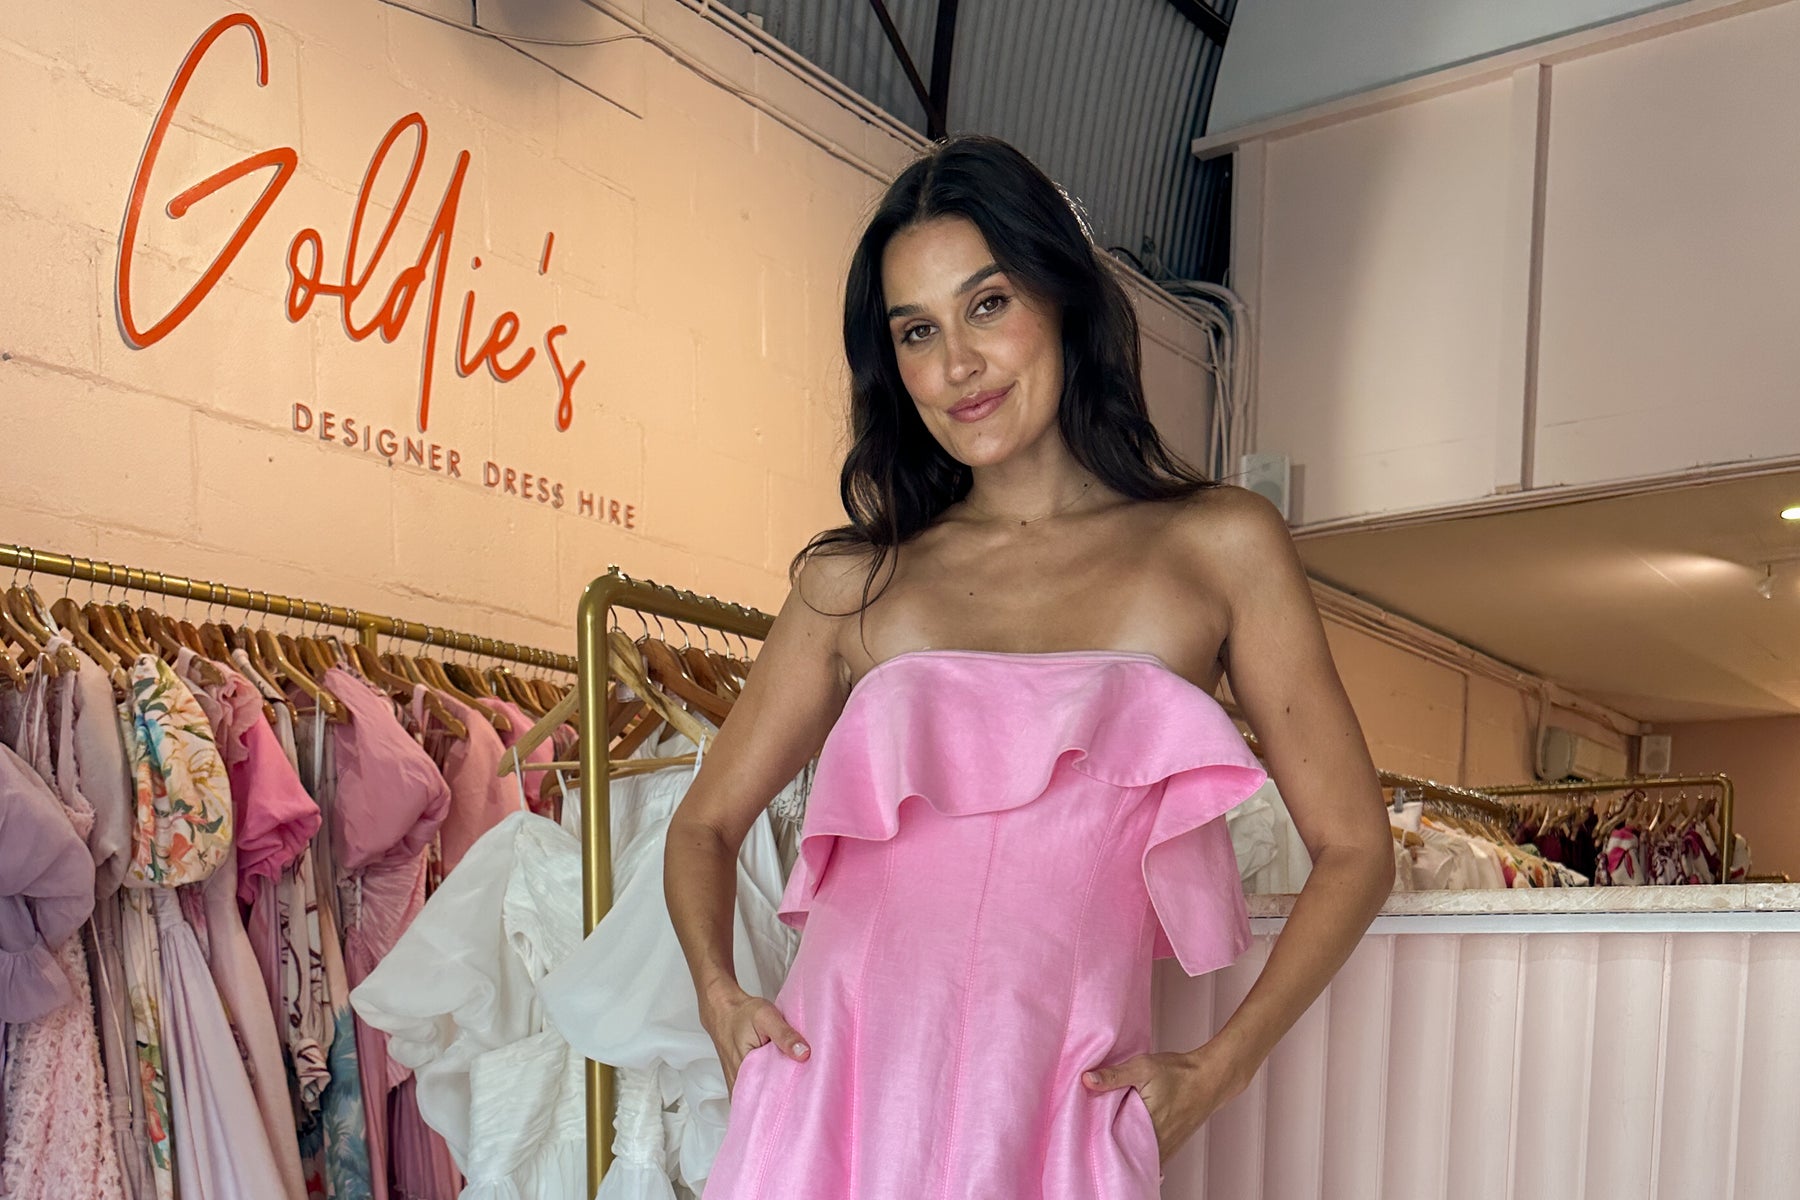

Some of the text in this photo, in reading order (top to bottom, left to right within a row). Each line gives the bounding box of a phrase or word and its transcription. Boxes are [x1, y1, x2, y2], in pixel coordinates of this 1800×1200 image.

[117, 13, 586, 431] Goldie's
[293, 402, 636, 529] DESIGNER DRESS HIRE
